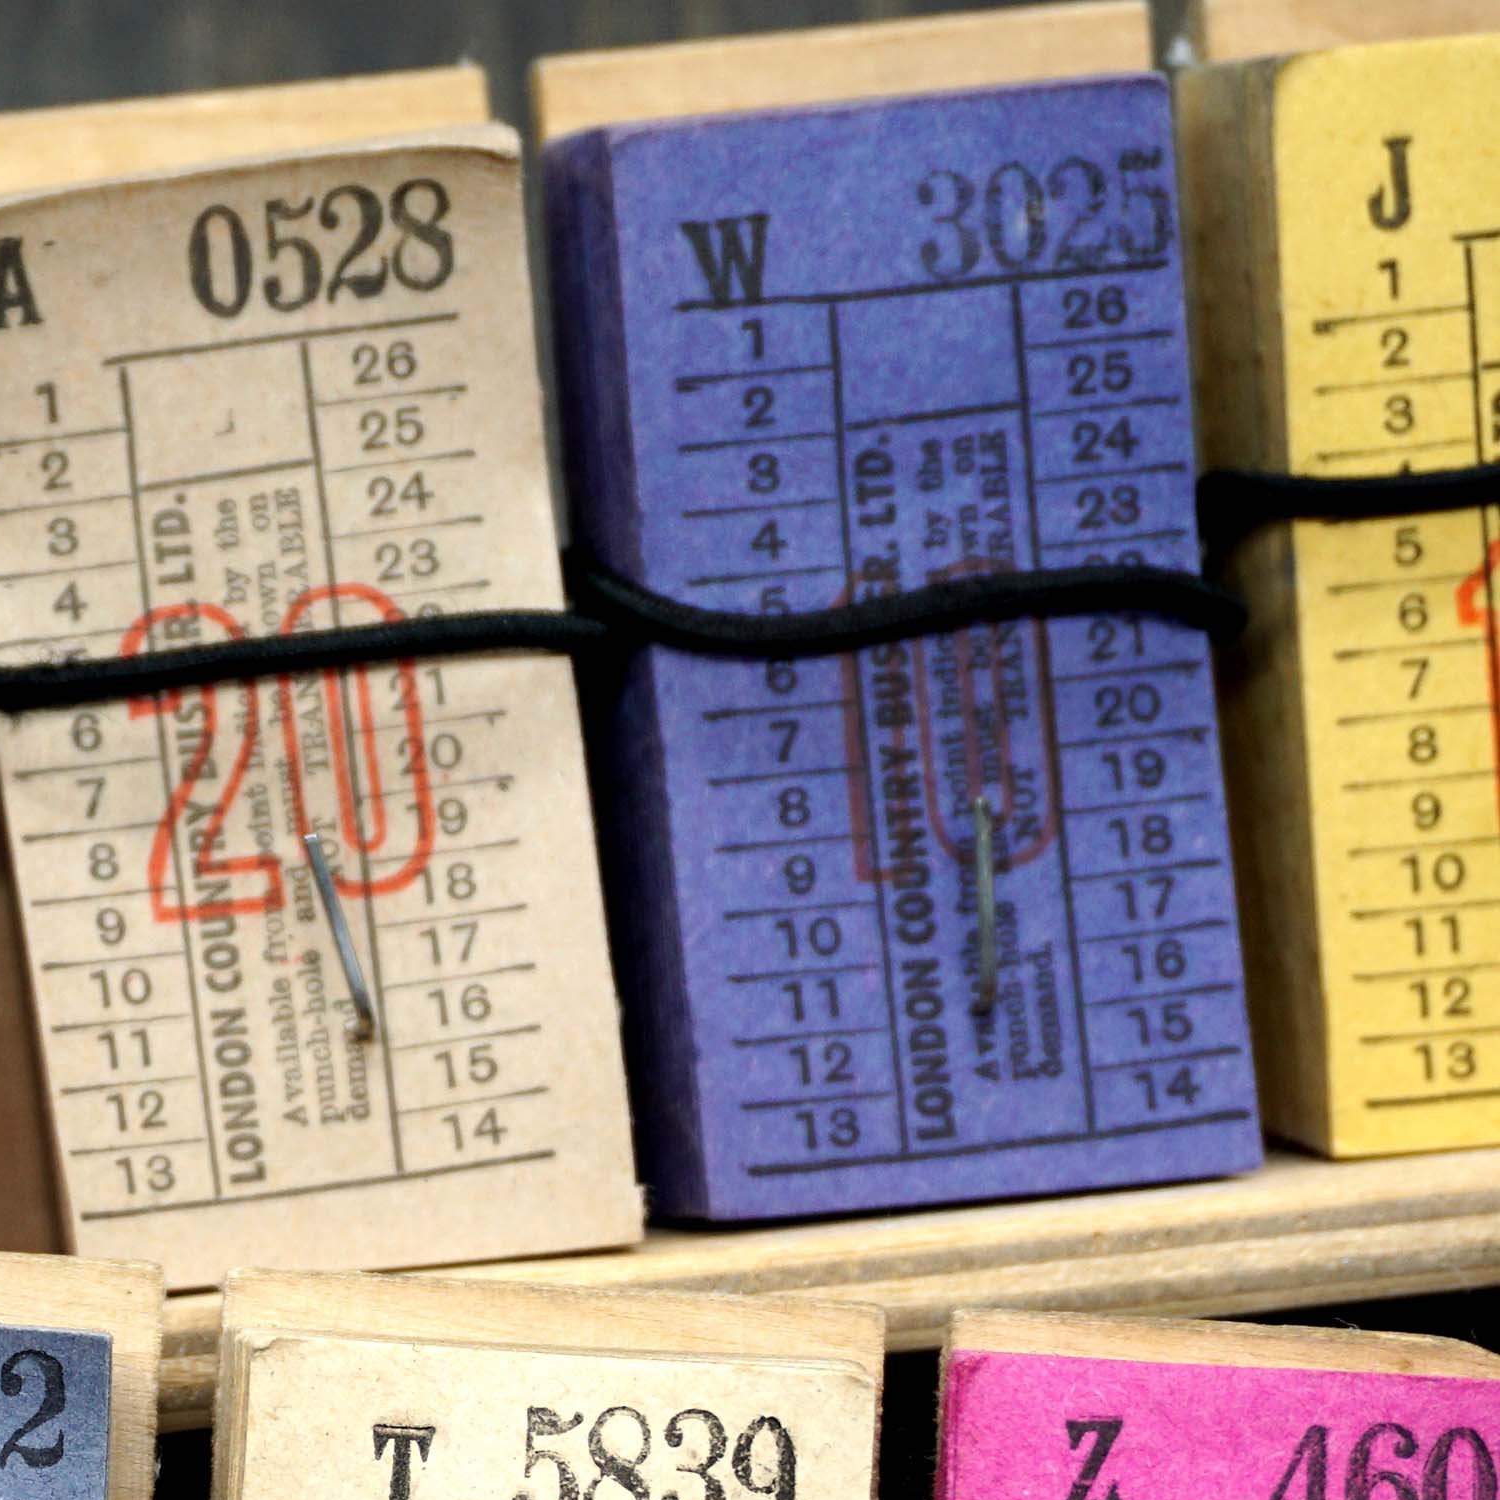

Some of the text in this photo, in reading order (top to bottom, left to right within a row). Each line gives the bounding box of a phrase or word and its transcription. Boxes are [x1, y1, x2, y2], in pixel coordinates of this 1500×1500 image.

[1368, 136, 1411, 231] J
[189, 178, 454, 318] 0528
[681, 148, 1171, 307] W 3025
[1379, 259, 1399, 299] 1
[1062, 286, 1128, 330] 26
[742, 319, 764, 360] 1
[1381, 327, 1409, 368] 2
[352, 341, 417, 385] 26
[1067, 350, 1133, 397] 25
[36, 382, 58, 424] 1
[743, 387, 774, 429] 2
[1384, 395, 1415, 435] 3
[360, 406, 424, 451] 25
[1073, 417, 1140, 463] 24
[40, 451, 71, 491] 2
[368, 472, 435, 517] 24
[854, 434, 956, 1141] LONDON COUNTRY LTD.
[217, 497, 309, 1128] Available the
[152, 493, 267, 1186] LONDON COUNTRY LTD.
[1402, 852, 1466, 893] 10
[1406, 913, 1460, 956] 11
[1410, 976, 1471, 1018] 12
[297, 949, 345, 1126] punch-hole
[1127, 1001, 1193, 1047] 15
[434, 1044, 498, 1089] 15
[1416, 1041, 1476, 1081] 13
[1134, 1067, 1201, 1110] 14
[442, 1108, 508, 1151] 14
[795, 1108, 860, 1151] 13
[116, 1155, 175, 1195] 13
